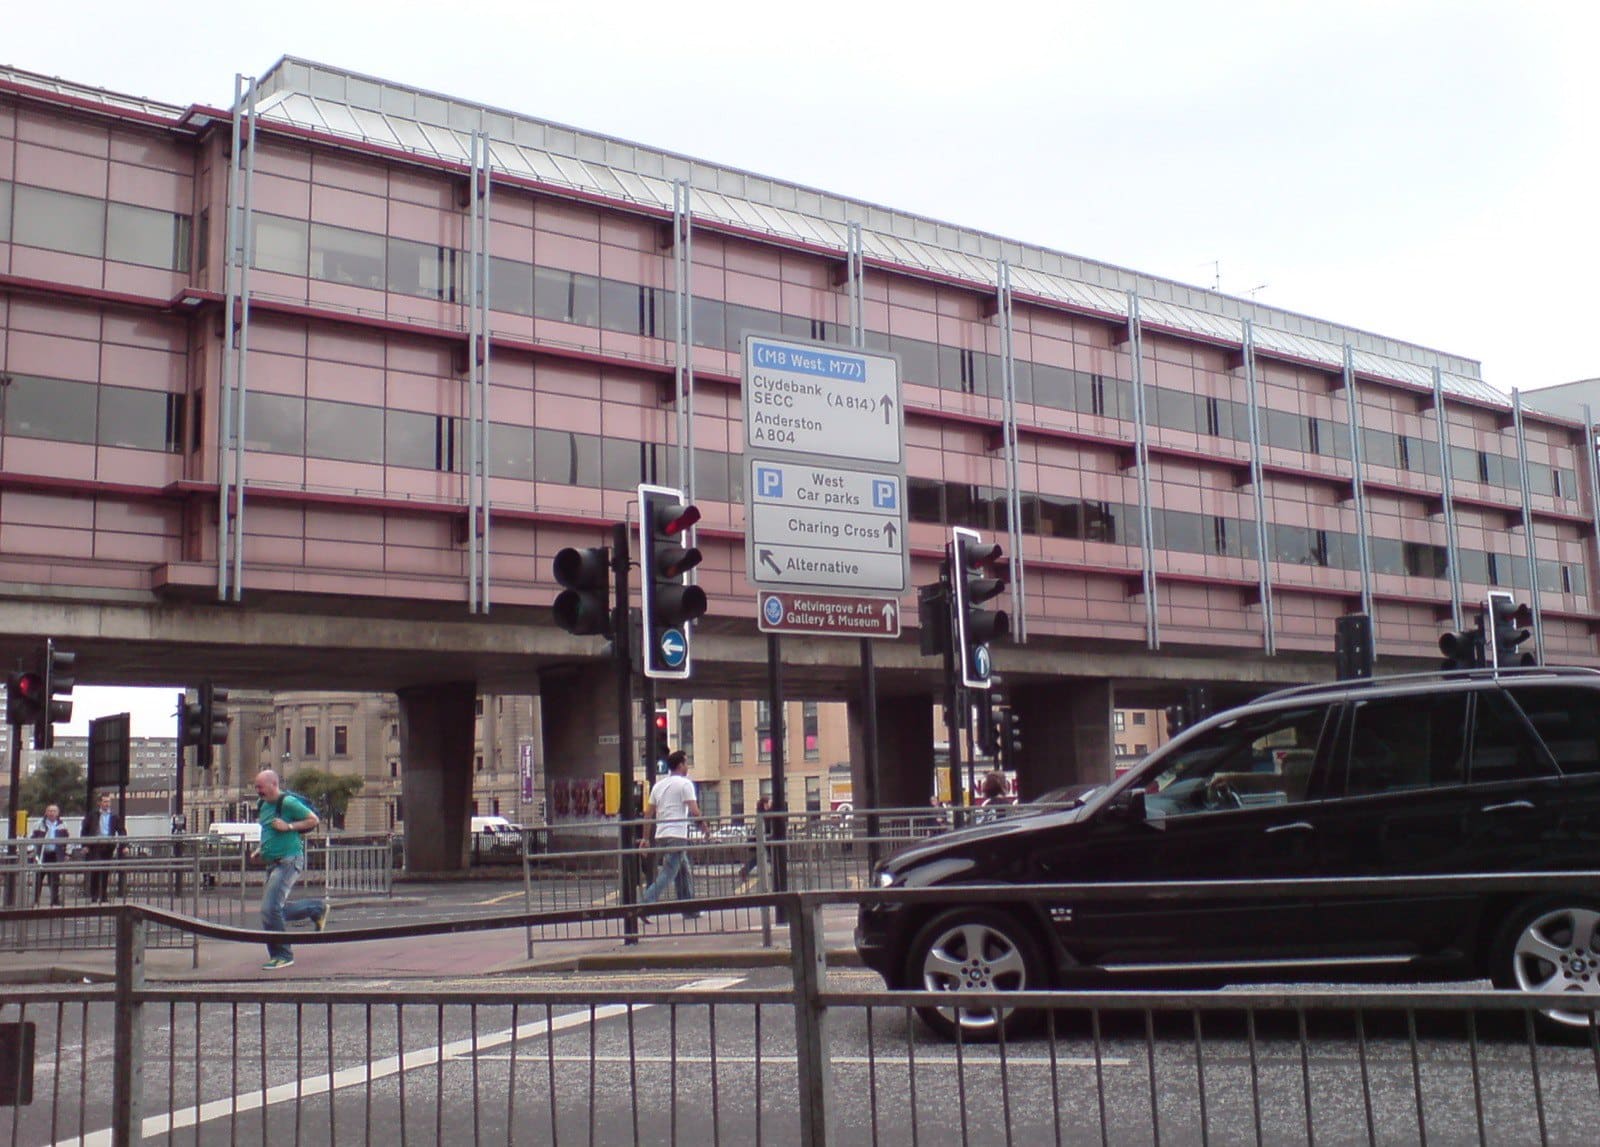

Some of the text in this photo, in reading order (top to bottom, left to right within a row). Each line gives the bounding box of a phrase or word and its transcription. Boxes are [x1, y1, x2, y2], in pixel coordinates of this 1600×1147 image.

[830, 360, 861, 377] M77)
[753, 375, 822, 396] Clydebank
[753, 391, 793, 408] SECC
[754, 411, 822, 431] Anderston
[763, 471, 779, 495] P
[811, 473, 844, 488] West
[797, 487, 860, 505] Car parks
[878, 483, 893, 505] P
[788, 518, 880, 539] Charing Cross
[786, 557, 859, 575] Alternative
[793, 600, 873, 615] Kelvingrove Art
[786, 612, 880, 628] Gallery & Museum
